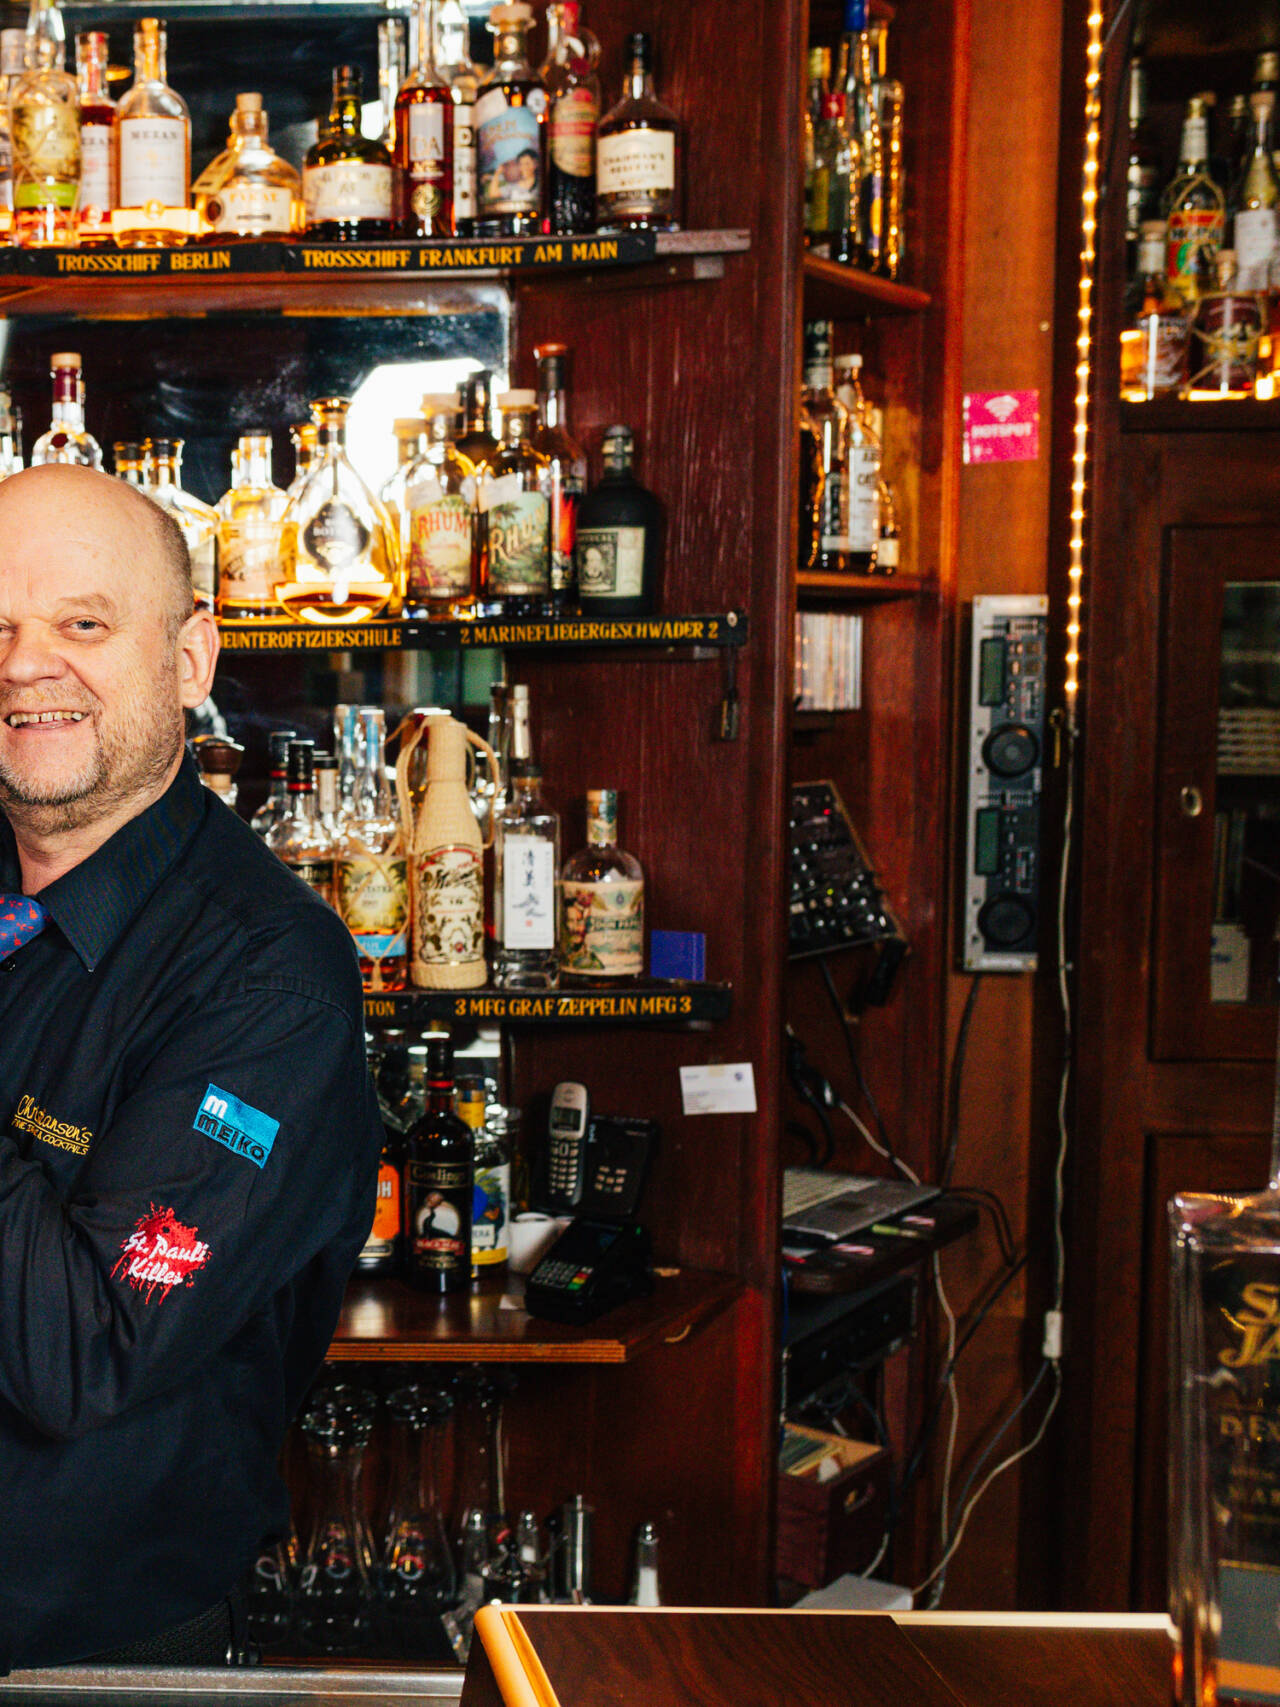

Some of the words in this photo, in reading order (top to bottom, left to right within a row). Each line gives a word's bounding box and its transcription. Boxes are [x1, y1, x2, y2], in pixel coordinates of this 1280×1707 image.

[56, 253, 162, 272] TROSSSCHIFF
[170, 250, 231, 271] BERLIN
[302, 249, 412, 269] TROSSSCHIFF
[419, 246, 525, 267] FRANKFURT
[534, 243, 563, 263] AM
[571, 240, 618, 263] MAIN
[460, 627, 471, 645] 2
[474, 621, 704, 645] MARINEFLIEGERGESCHWADER
[708, 620, 719, 640] 2
[455, 999, 467, 1017] 3
[470, 998, 506, 1017] MFG
[509, 997, 556, 1017] GRAF
[557, 996, 637, 1017] ZEPPELIN
[640, 996, 677, 1016] MFG
[680, 996, 693, 1014] 3
[42, 1133, 89, 1156] COCKTAILS
[124, 1230, 150, 1254] St.
[148, 1233, 210, 1262] Pauli
[127, 1256, 184, 1286] Killer
